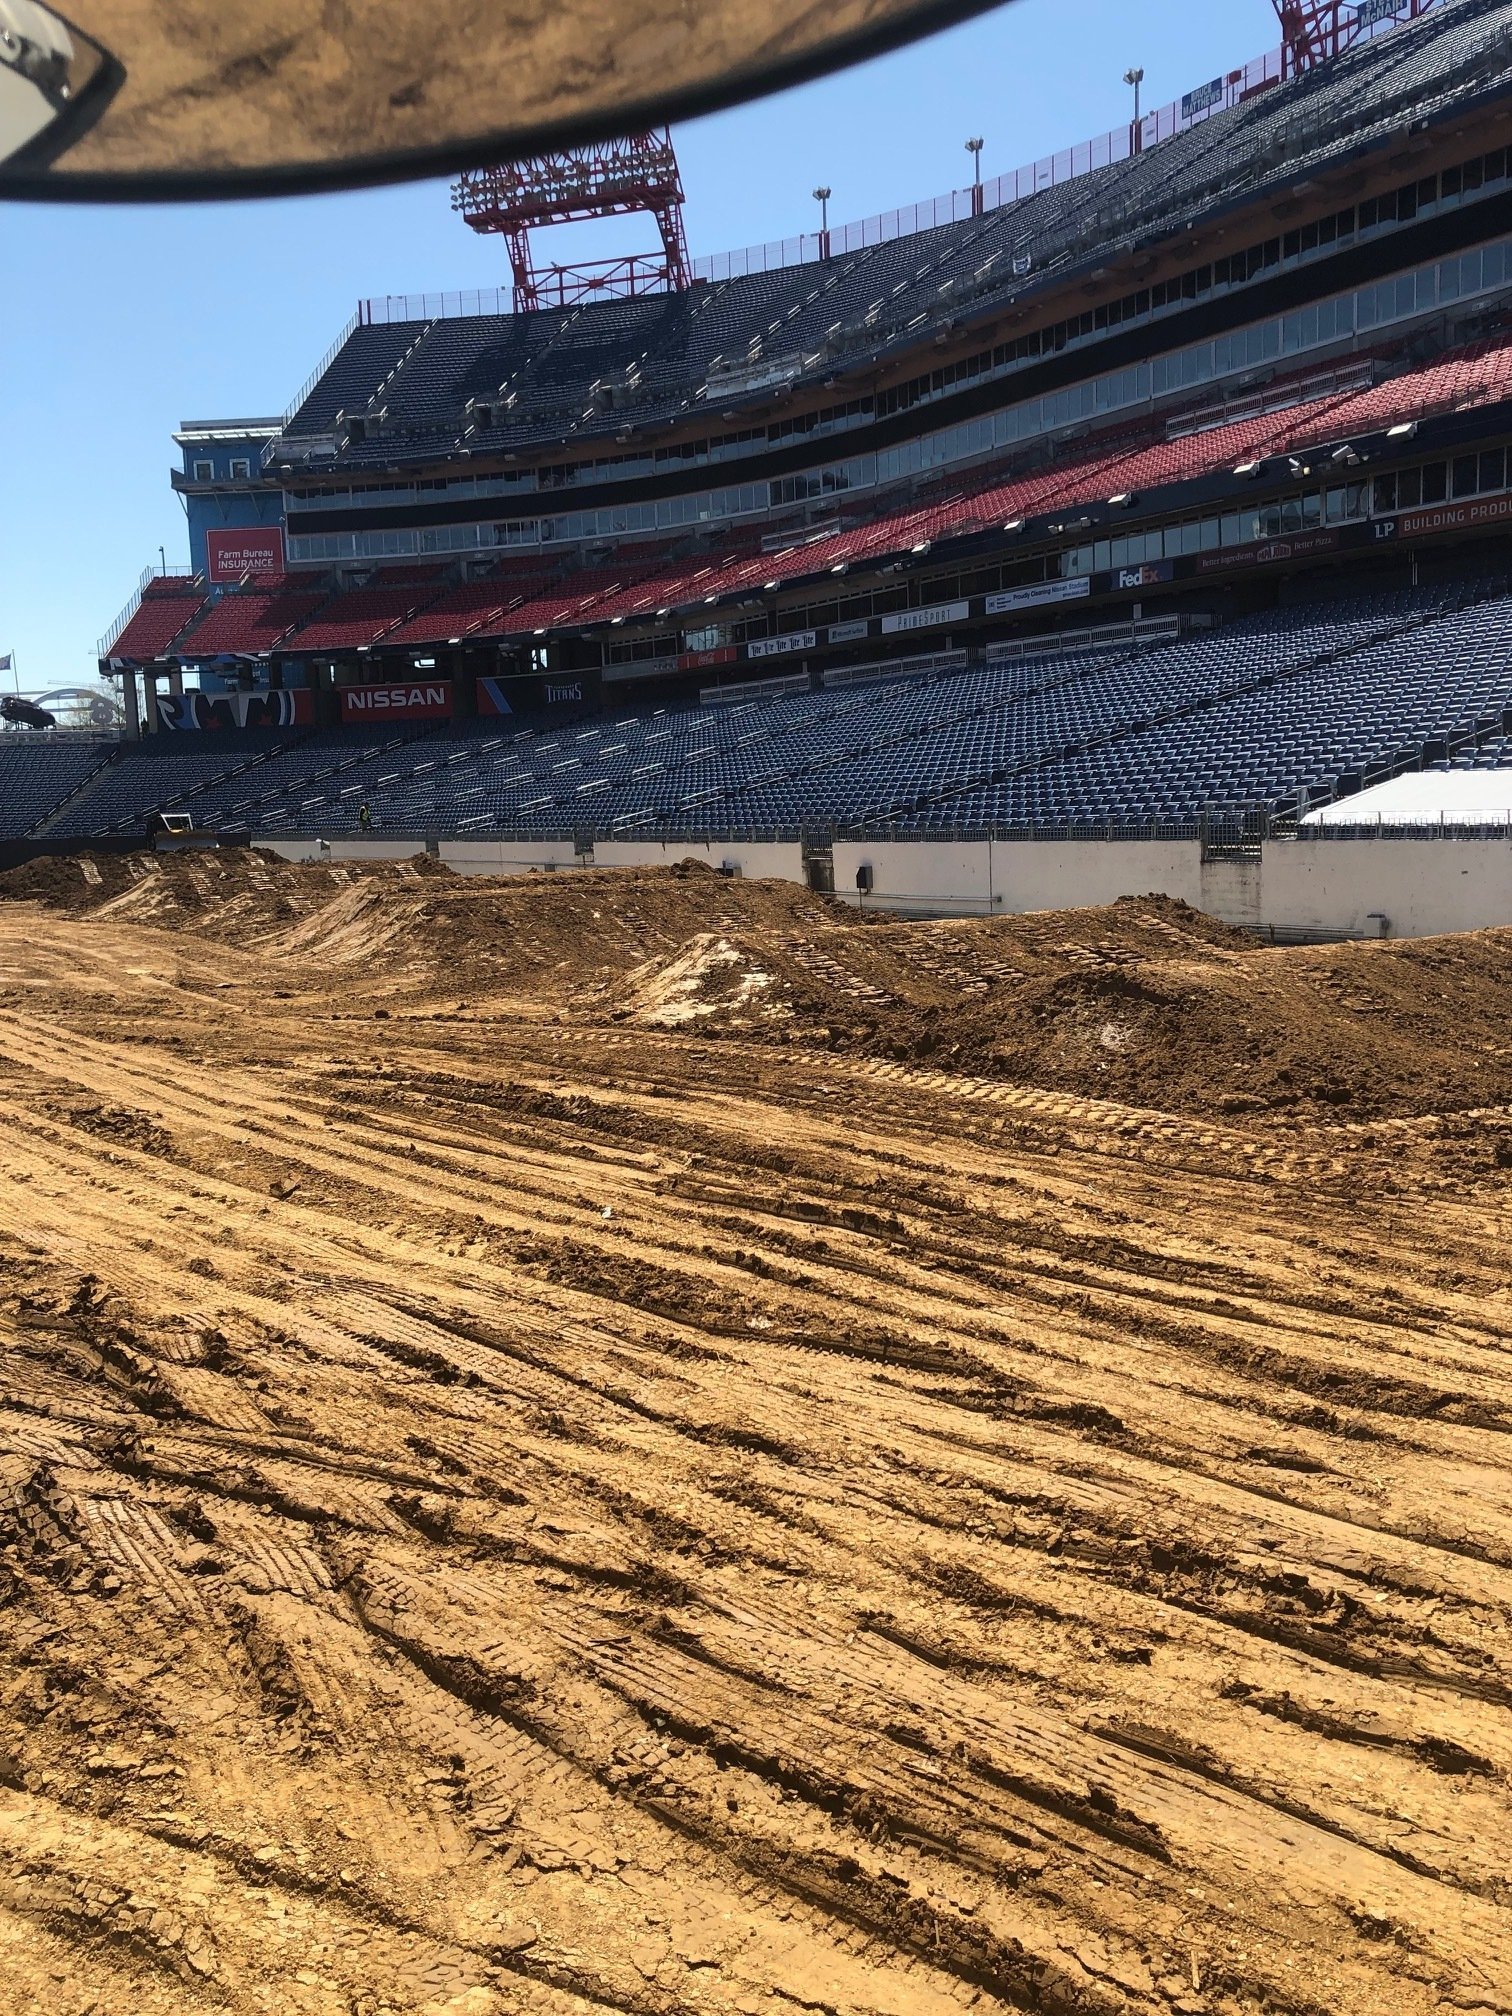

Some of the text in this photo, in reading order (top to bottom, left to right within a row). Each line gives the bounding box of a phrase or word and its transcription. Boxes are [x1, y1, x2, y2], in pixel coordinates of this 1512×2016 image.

[1361, 0, 1403, 27] McNAIR
[1182, 89, 1221, 119] MATTHEWS
[1375, 522, 1395, 538] LP
[1404, 509, 1465, 532] BUILDING
[218, 549, 274, 559] Farm Bureau
[1294, 541, 1314, 551] Better
[218, 558, 274, 570] INSURANCE
[1202, 558, 1220, 568] Better
[1119, 565, 1159, 588] FedEx
[1013, 592, 1031, 602] Proudly
[1031, 588, 1052, 598] Cleaning
[776, 639, 787, 652] Lite
[789, 637, 800, 650] Lite
[803, 634, 814, 648] Lite
[348, 687, 445, 709] NISSAN
[544, 682, 582, 703] TITANS
